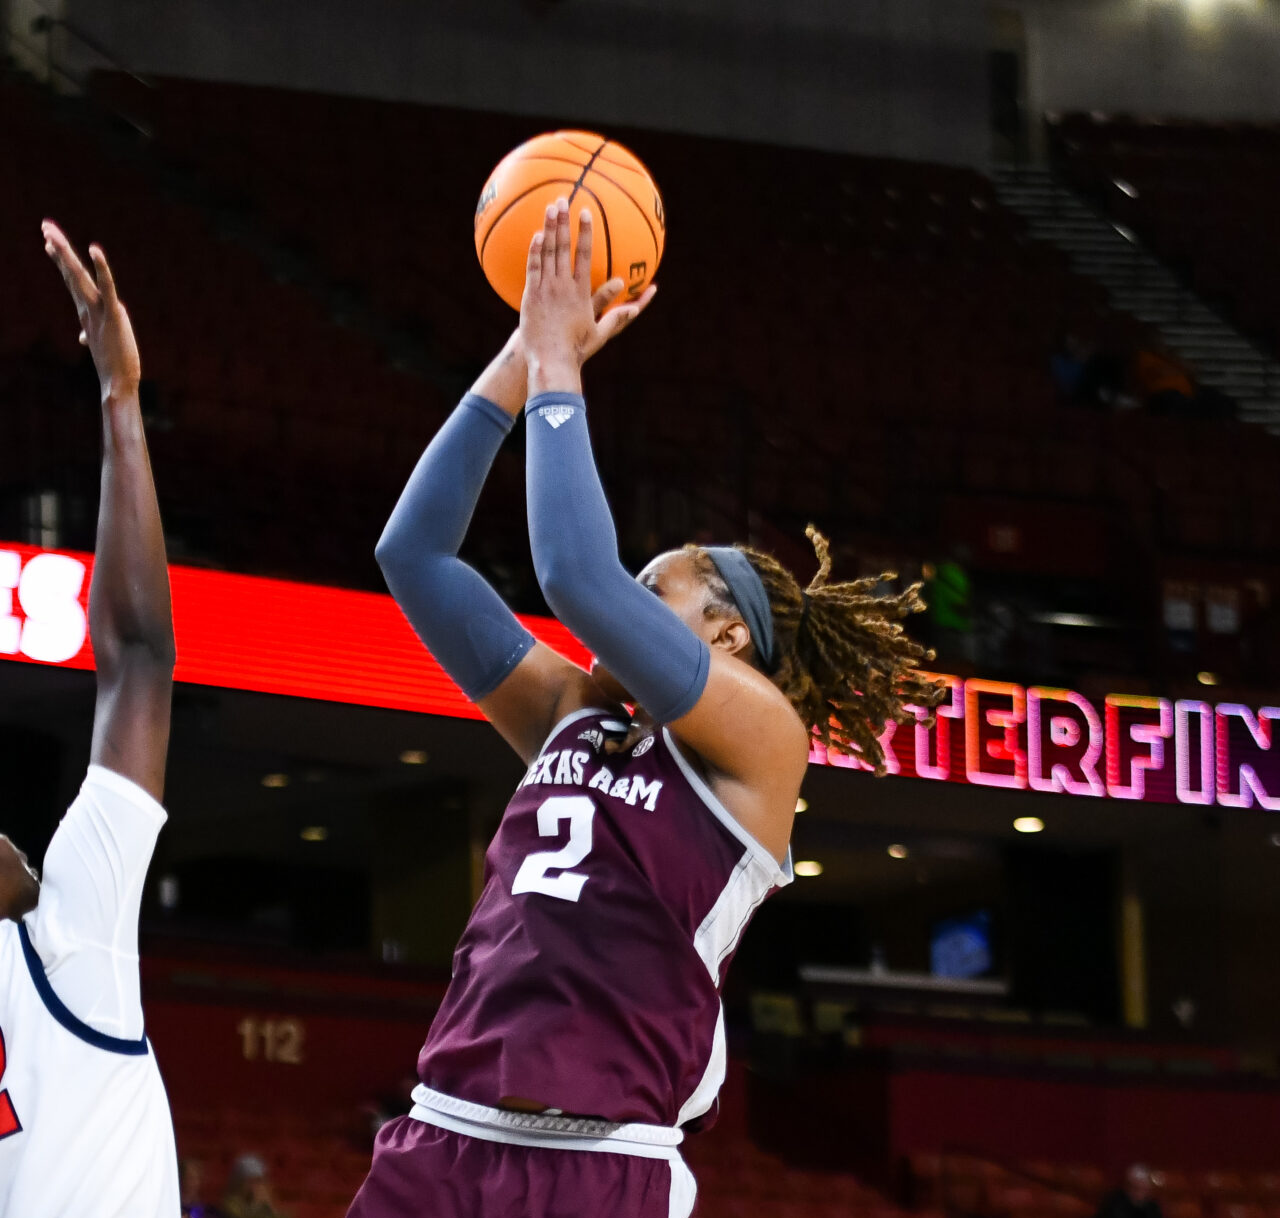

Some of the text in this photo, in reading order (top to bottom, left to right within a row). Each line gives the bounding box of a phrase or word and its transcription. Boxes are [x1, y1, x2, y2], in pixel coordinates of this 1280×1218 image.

[588, 766, 663, 812] A&M
[511, 796, 596, 902] 2
[237, 1018, 303, 1064] 112
